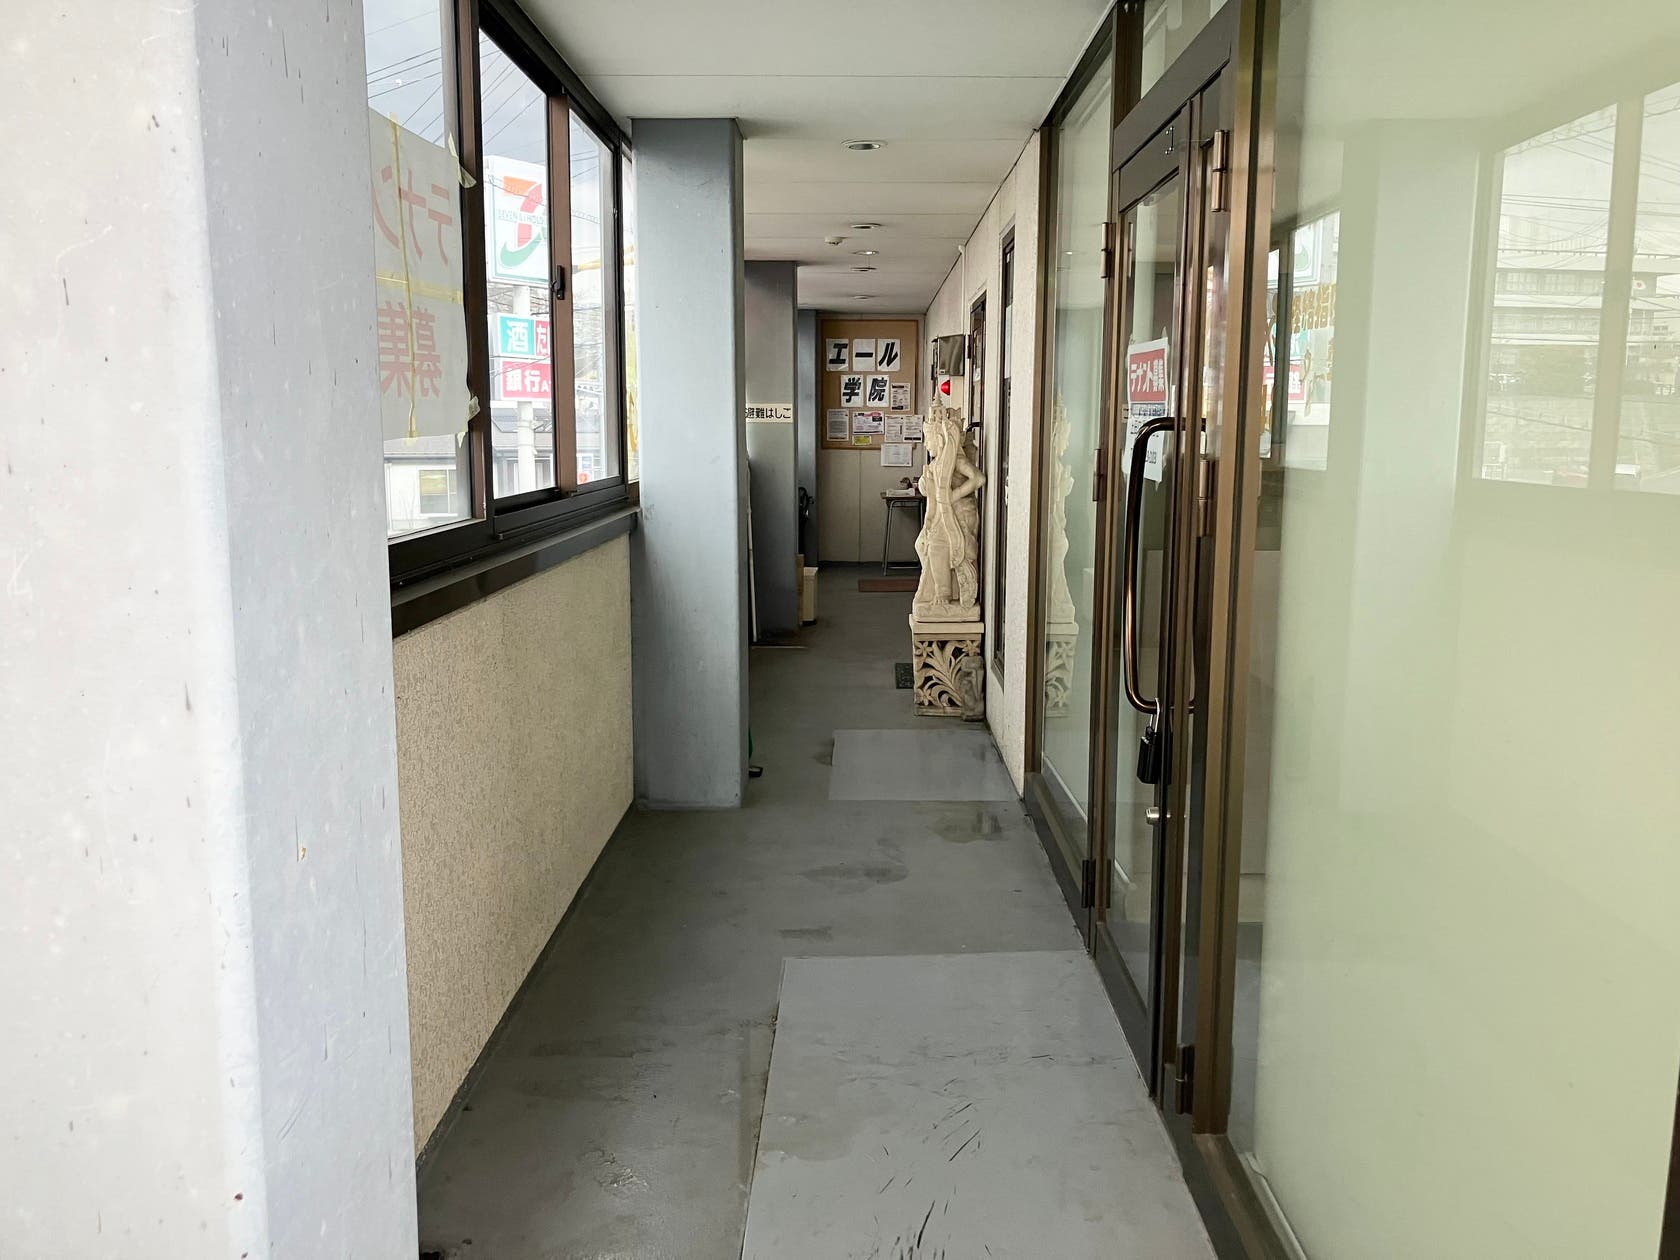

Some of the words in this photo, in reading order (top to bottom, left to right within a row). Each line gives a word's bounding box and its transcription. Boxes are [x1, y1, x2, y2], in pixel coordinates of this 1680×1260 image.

[506, 320, 529, 353] 酒
[828, 342, 899, 367] エール
[505, 368, 552, 393] 銀行A
[842, 376, 888, 404] 学院
